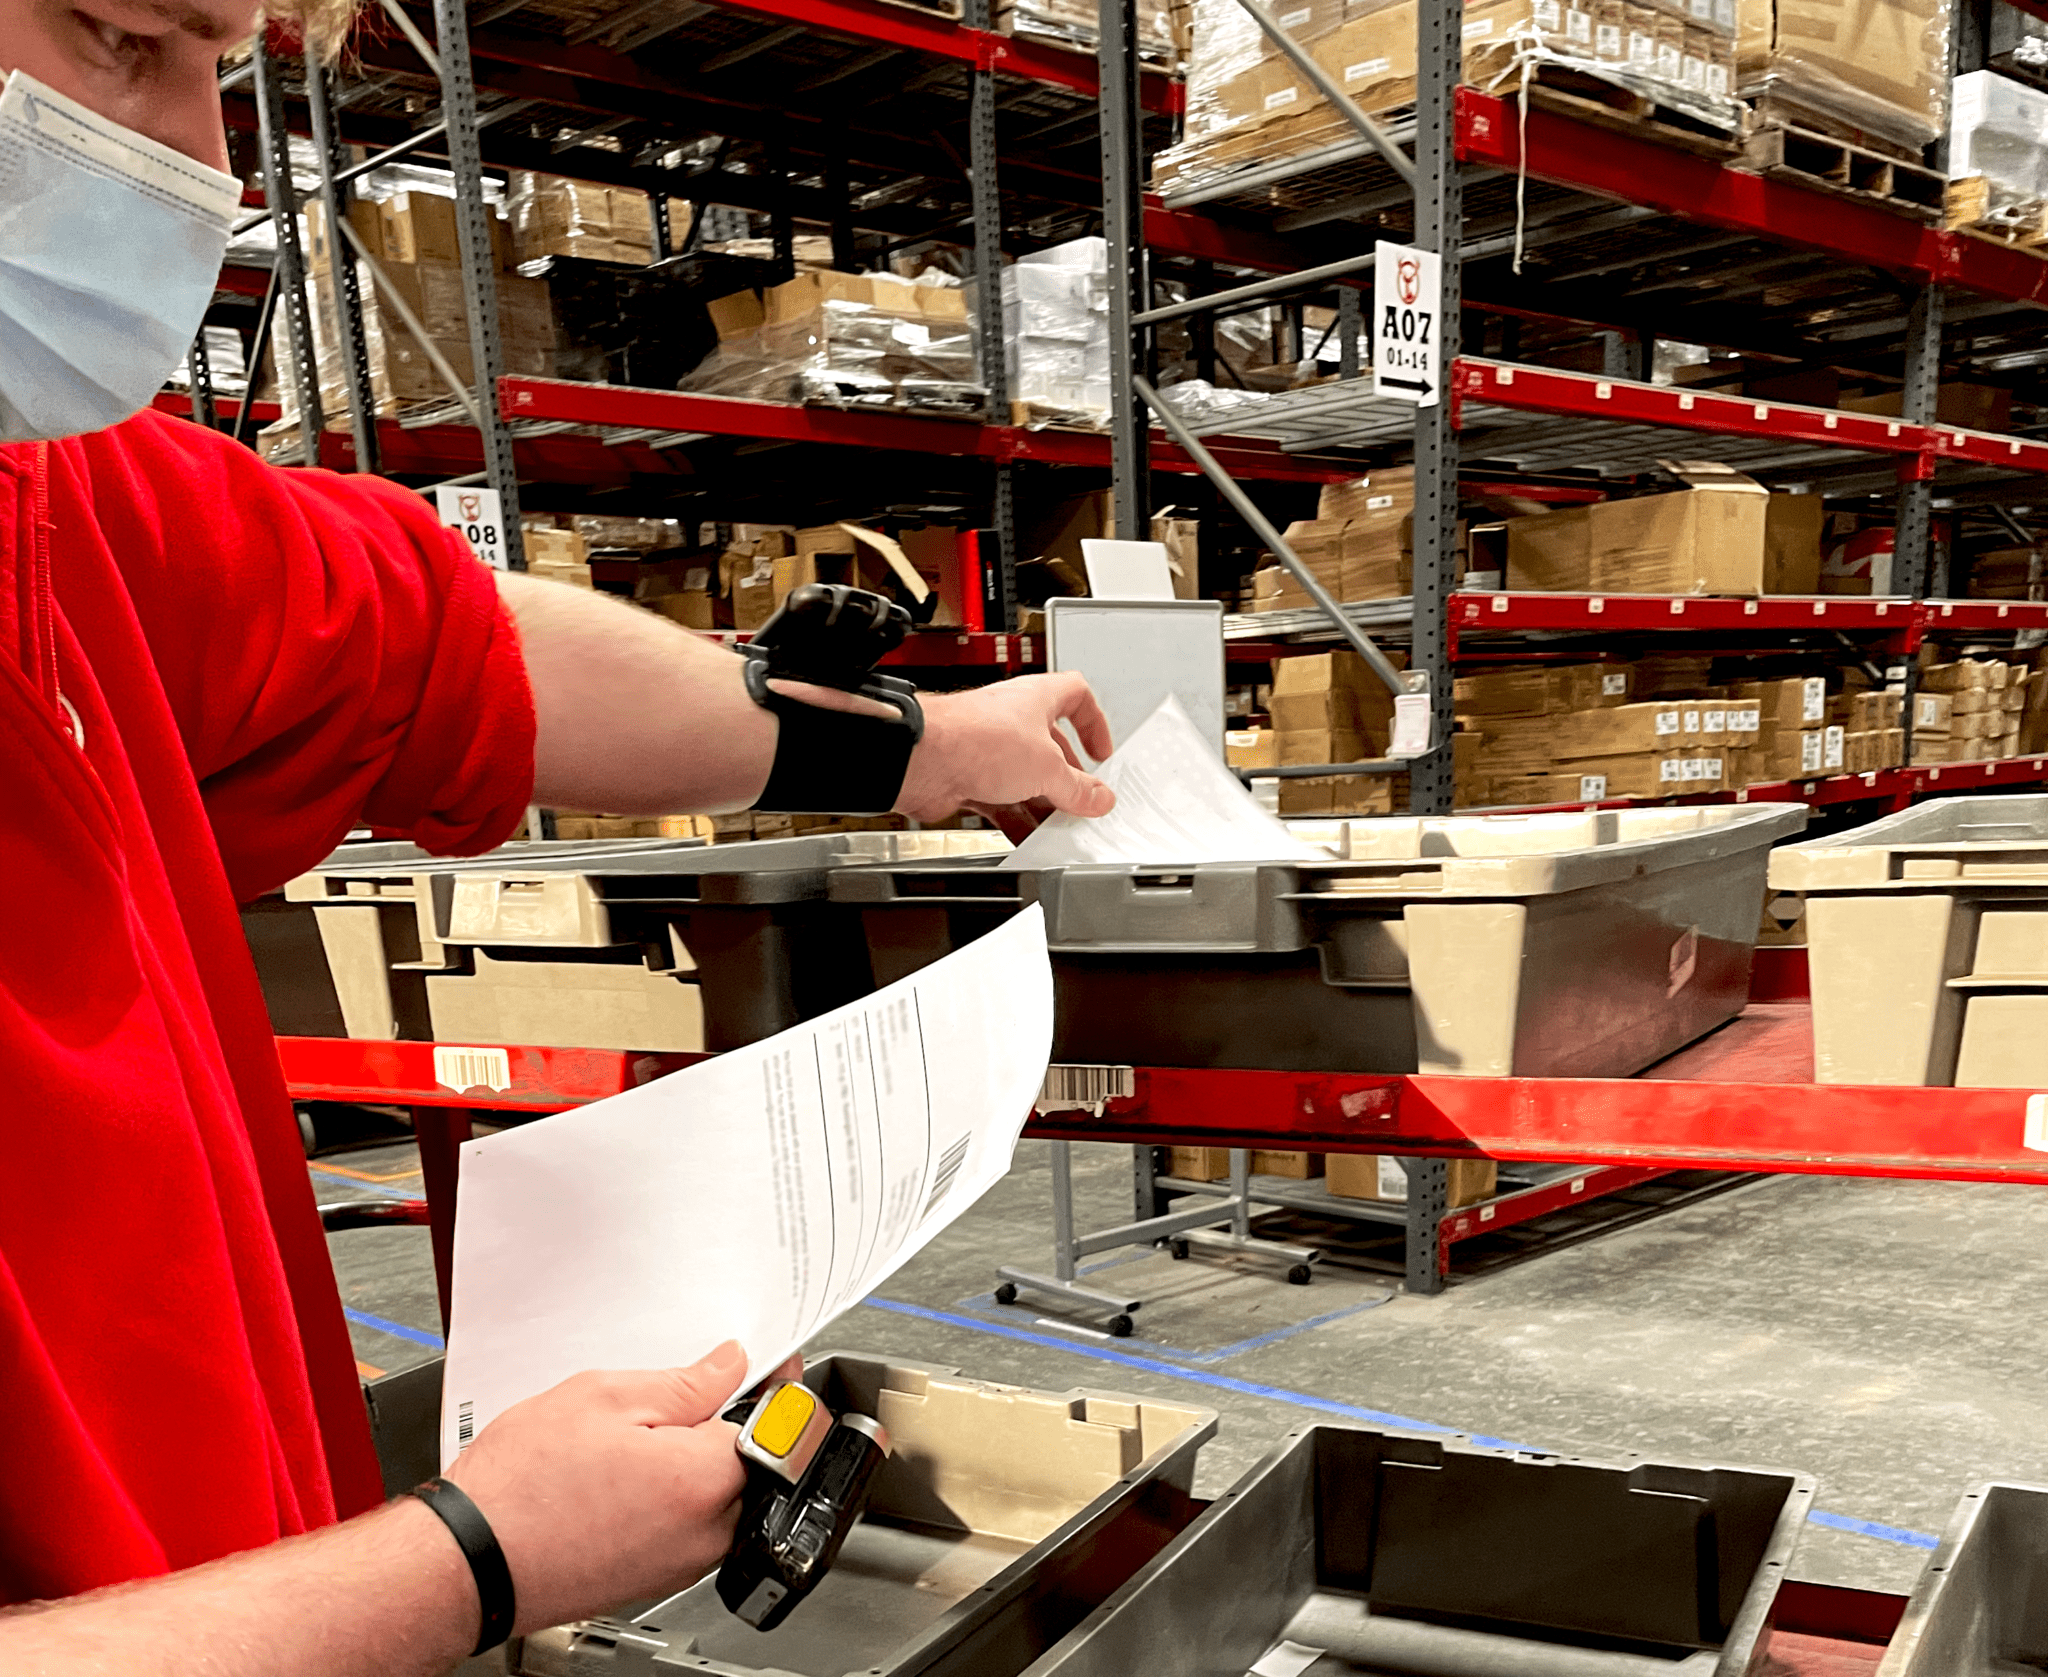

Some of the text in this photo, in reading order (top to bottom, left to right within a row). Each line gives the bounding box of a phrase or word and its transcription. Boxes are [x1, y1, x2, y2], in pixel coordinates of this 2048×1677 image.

[1382, 305, 1432, 344] A07
[1386, 347, 1428, 370] 01-14
[451, 524, 497, 545] 08
